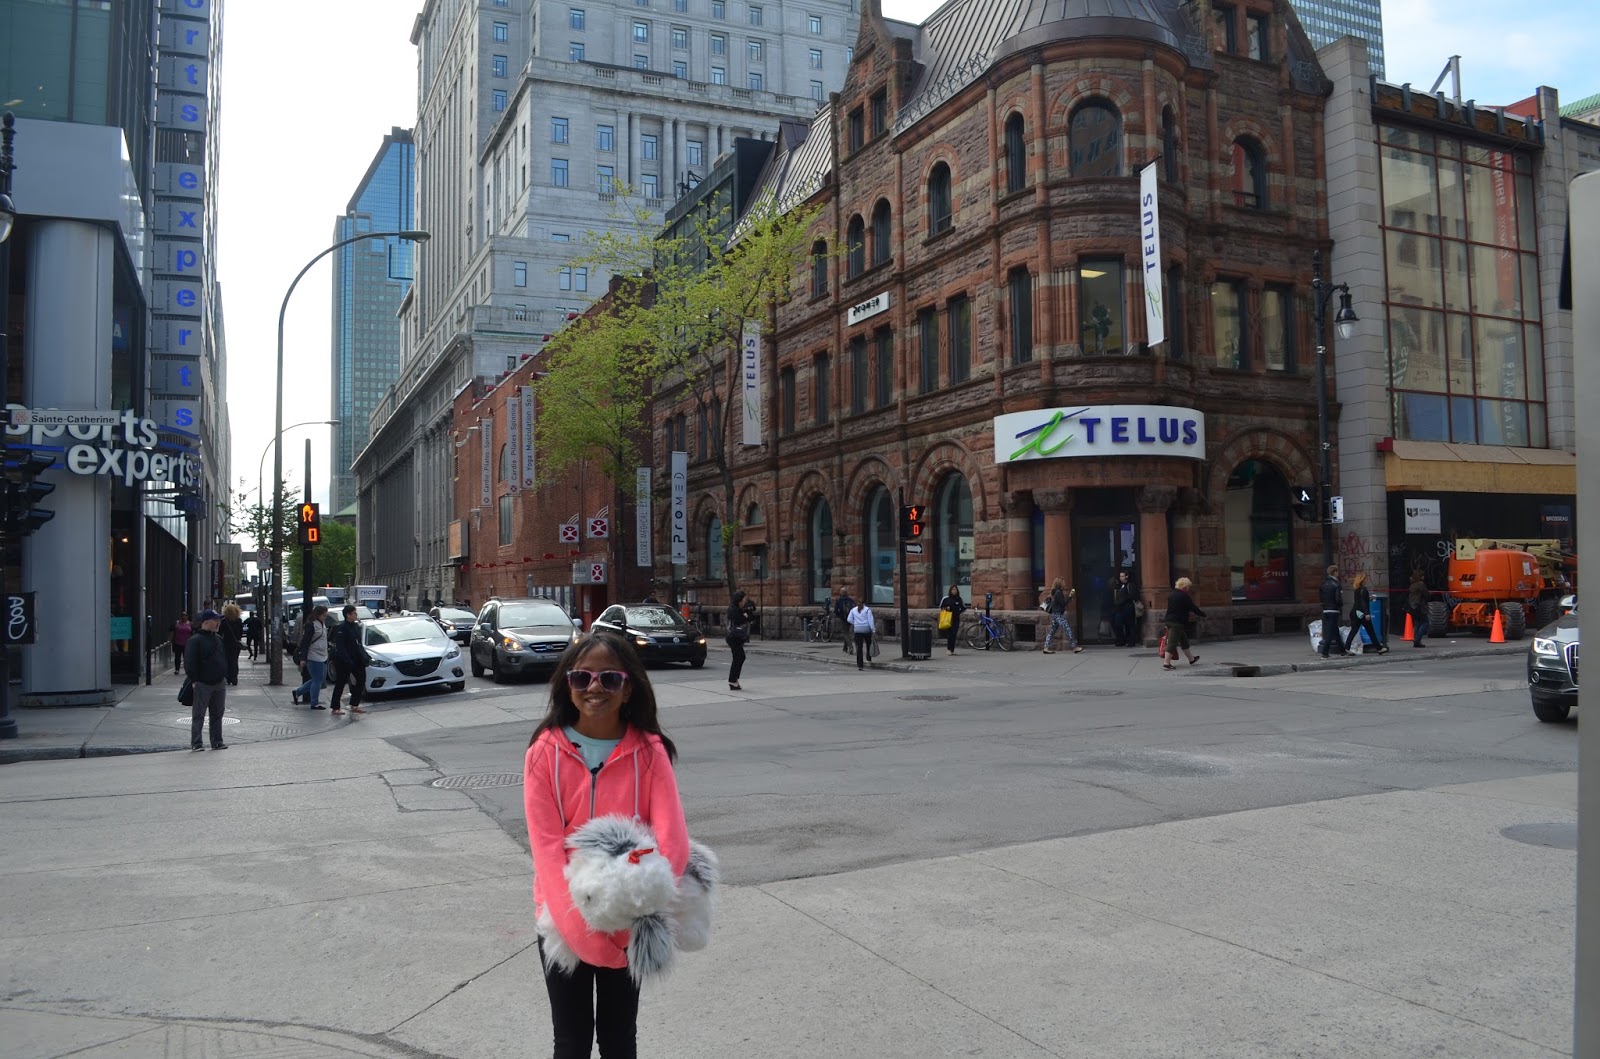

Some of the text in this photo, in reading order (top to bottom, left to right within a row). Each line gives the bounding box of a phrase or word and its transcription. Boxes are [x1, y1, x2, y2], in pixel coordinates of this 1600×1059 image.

[1143, 192, 1156, 274] TELUS
[175, 170, 198, 428] experts
[746, 338, 756, 391] TELUS
[31, 414, 115, 424] Sainte-Catherine
[1079, 417, 1198, 445] TELUS
[67, 444, 194, 487] experts
[308, 528, 318, 542] 0
[913, 524, 919, 535] 0
[640, 540, 648, 563] CENTRE
[1459, 574, 1476, 582] JLG
